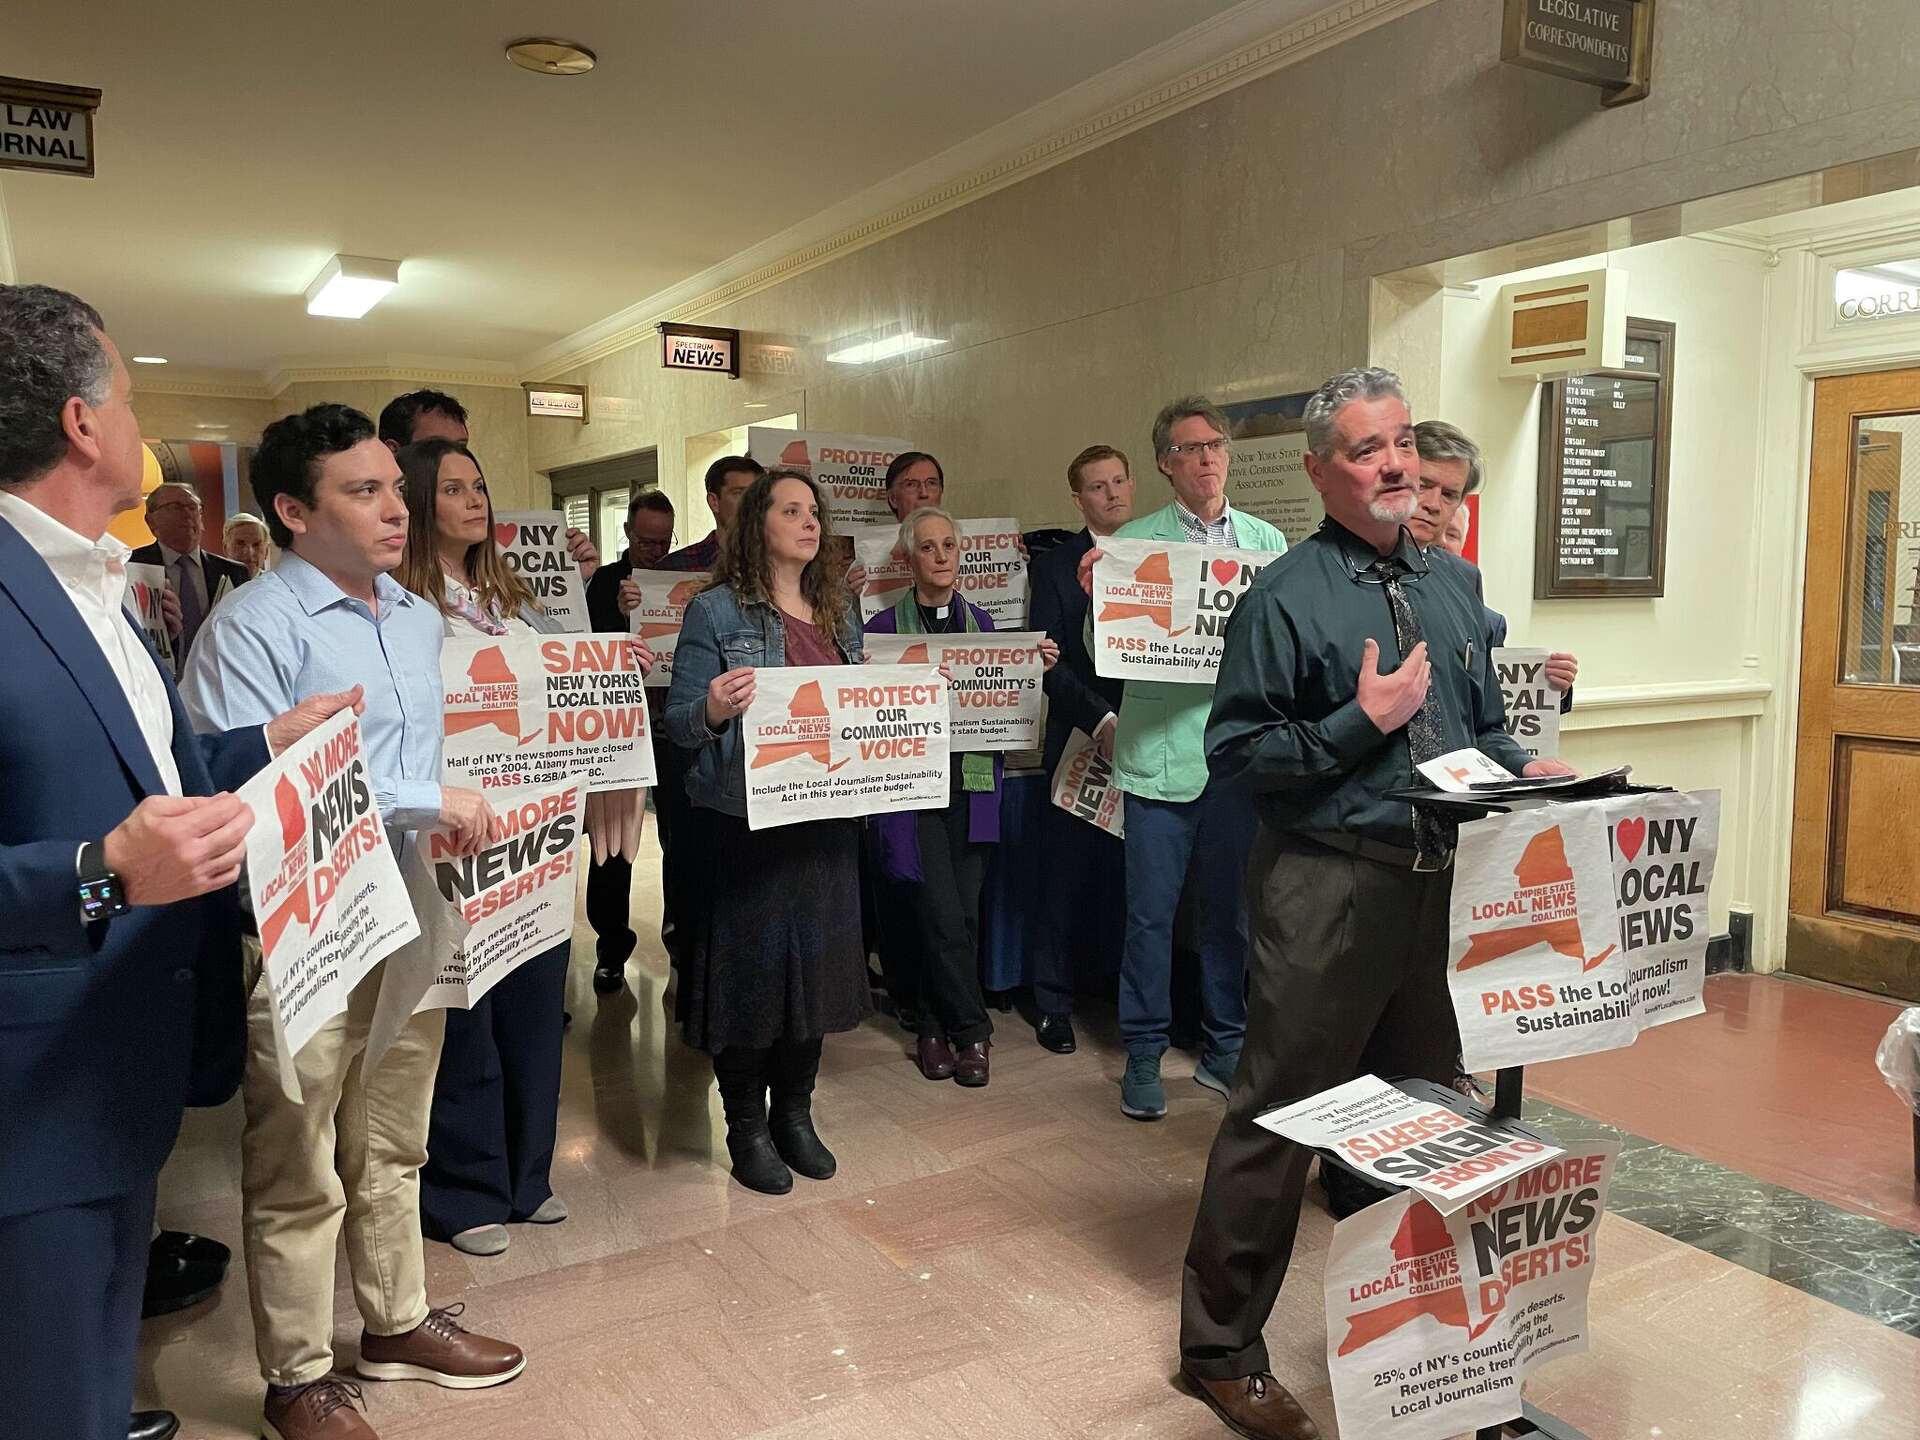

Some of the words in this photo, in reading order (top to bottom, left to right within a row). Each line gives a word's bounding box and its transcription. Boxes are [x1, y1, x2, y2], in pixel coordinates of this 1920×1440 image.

[1539, 0, 1620, 32] LEGISLATIVE
[1527, 21, 1628, 62] CORRESPONDENTS
[7, 104, 72, 131] LAW
[0, 132, 85, 160] RNAL
[675, 341, 713, 351] SPECTRUM
[673, 349, 724, 366] NEWS
[1280, 448, 1300, 458] STATE
[818, 474, 887, 487] COMMUNIT
[850, 466, 875, 476] OUR
[833, 486, 888, 500] VOICE
[1235, 479, 1284, 490] ASSOCIATION
[520, 525, 558, 546] NY
[501, 551, 575, 572] OCAL
[965, 552, 991, 562] OUR
[868, 566, 897, 574] LOCAL
[976, 598, 1026, 607] Sustainability
[1106, 586, 1138, 597] LOCAL
[1142, 590, 1173, 600] NEWS
[1108, 636, 1147, 651] PASS
[1150, 642, 1170, 654] the
[1174, 644, 1205, 656] Local
[542, 640, 636, 674] SAVE
[942, 648, 1040, 666] PROTECT
[1121, 652, 1201, 669] Sustainability
[546, 675, 584, 691] NEW
[588, 674, 640, 690] YORK'S
[975, 666, 1004, 678] OUR
[1498, 663, 1543, 684] NY
[444, 692, 478, 705] OCAL
[482, 690, 518, 702] NEWS
[470, 684, 496, 692] EMPIRE
[838, 684, 940, 710] PROTECT
[482, 702, 518, 710] COALITION
[547, 692, 599, 708] LOCAL
[602, 690, 642, 705] NEWS
[958, 690, 1020, 708] VOICE
[876, 708, 907, 722] OUR
[981, 718, 1034, 726] Sustainability
[548, 708, 644, 744] NOW!
[758, 726, 796, 736] LOCAL
[798, 723, 830, 734] NEWS
[798, 732, 830, 740] COALITION
[841, 722, 942, 740] COMMUNITY'S
[299, 751, 325, 798] NO
[324, 720, 359, 778] MORE
[447, 757, 469, 768] Half
[472, 756, 484, 765] of
[486, 752, 512, 764] NY's
[515, 749, 574, 761] newsrooms
[576, 746, 600, 756] have
[602, 742, 634, 753] closed
[860, 737, 927, 760] VOICE
[468, 767, 498, 776] since
[500, 762, 532, 774] 2004.
[534, 758, 568, 770] Albany
[570, 758, 595, 768] must
[598, 754, 616, 764] act.
[482, 772, 522, 789] PASS
[752, 785, 787, 796] Include
[789, 782, 804, 791] the
[806, 779, 832, 789] Local
[834, 775, 884, 786] Journalism
[886, 770, 942, 782] Sustainability
[782, 794, 797, 802] Act
[800, 792, 808, 800] in
[810, 790, 828, 800] this
[830, 787, 858, 798] year's
[860, 786, 882, 796] state
[884, 782, 915, 793] budget.
[312, 759, 370, 864] NEWS
[492, 786, 578, 844] MORE
[1648, 817, 1698, 856] NY
[434, 814, 576, 902] NEWS
[464, 850, 575, 926] ESERTS!
[1514, 888, 1548, 900] EMPIRE
[1550, 882, 1576, 893] STATE
[1472, 899, 1528, 921] LOCAL
[1532, 890, 1576, 912] NEWS
[1531, 907, 1577, 923] COALITION
[472, 938, 486, 954] are
[488, 922, 513, 942] news
[514, 901, 552, 926] deserts.
[467, 939, 520, 985] Sustainability
[522, 926, 542, 943] Act.
[472, 952, 482, 971] by
[484, 930, 518, 960] passing
[520, 920, 535, 934] the
[292, 968, 339, 1015] Journalism
[364, 916, 379, 936] Act.
[306, 963, 318, 978] the
[1481, 984, 1556, 1016] PASS
[1559, 985, 1592, 1004] the
[1515, 1001, 1630, 1034] Sustainabili
[1642, 978, 1670, 1001] now!
[1335, 1088, 1401, 1114] Sustainability
[1337, 1110, 1470, 1162] ESERTS!
[1372, 1124, 1514, 1179] NEWS
[1418, 1152, 1520, 1190] MORE
[1514, 1155, 1606, 1202] MORE
[1470, 1188, 1600, 1278] NEWS
[1390, 1258, 1428, 1274] EMPIRE
[1428, 1248, 1457, 1266] STATE
[1350, 1275, 1405, 1303] LOCAL
[1409, 1258, 1460, 1285] NEWS
[1409, 1276, 1462, 1295] COALITION
[1374, 1366, 1406, 1388] 25%
[1408, 1362, 1424, 1378] of
[1426, 1354, 1460, 1374] NY's
[1528, 1292, 1566, 1314] deserts.
[1400, 1372, 1459, 1398] Reverse
[1462, 1364, 1486, 1380] the
[1533, 1312, 1548, 1326] the
[1391, 1396, 1431, 1418] Local
[1434, 1374, 1515, 1405] Journalism
[1536, 1324, 1554, 1340] Act.
